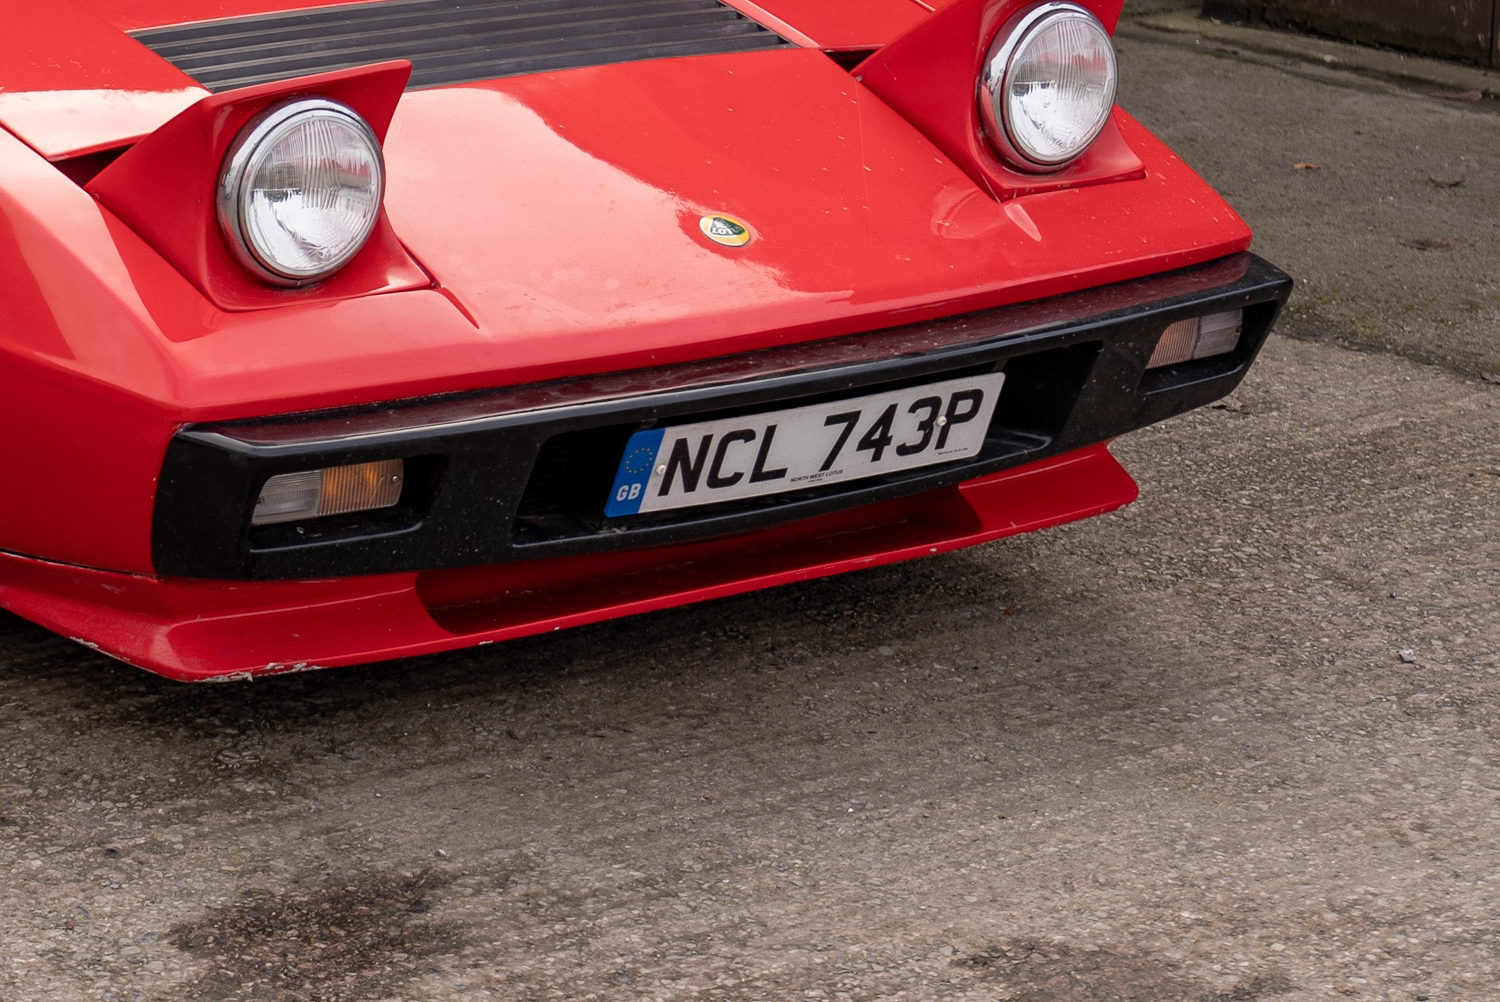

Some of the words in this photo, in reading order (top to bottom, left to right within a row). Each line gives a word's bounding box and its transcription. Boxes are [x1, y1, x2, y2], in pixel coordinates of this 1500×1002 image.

[657, 424, 788, 497] NCL
[819, 388, 984, 472] 743P
[790, 475, 810, 483] NORTH
[825, 469, 844, 477] LOTUS
[616, 483, 641, 501] GB
